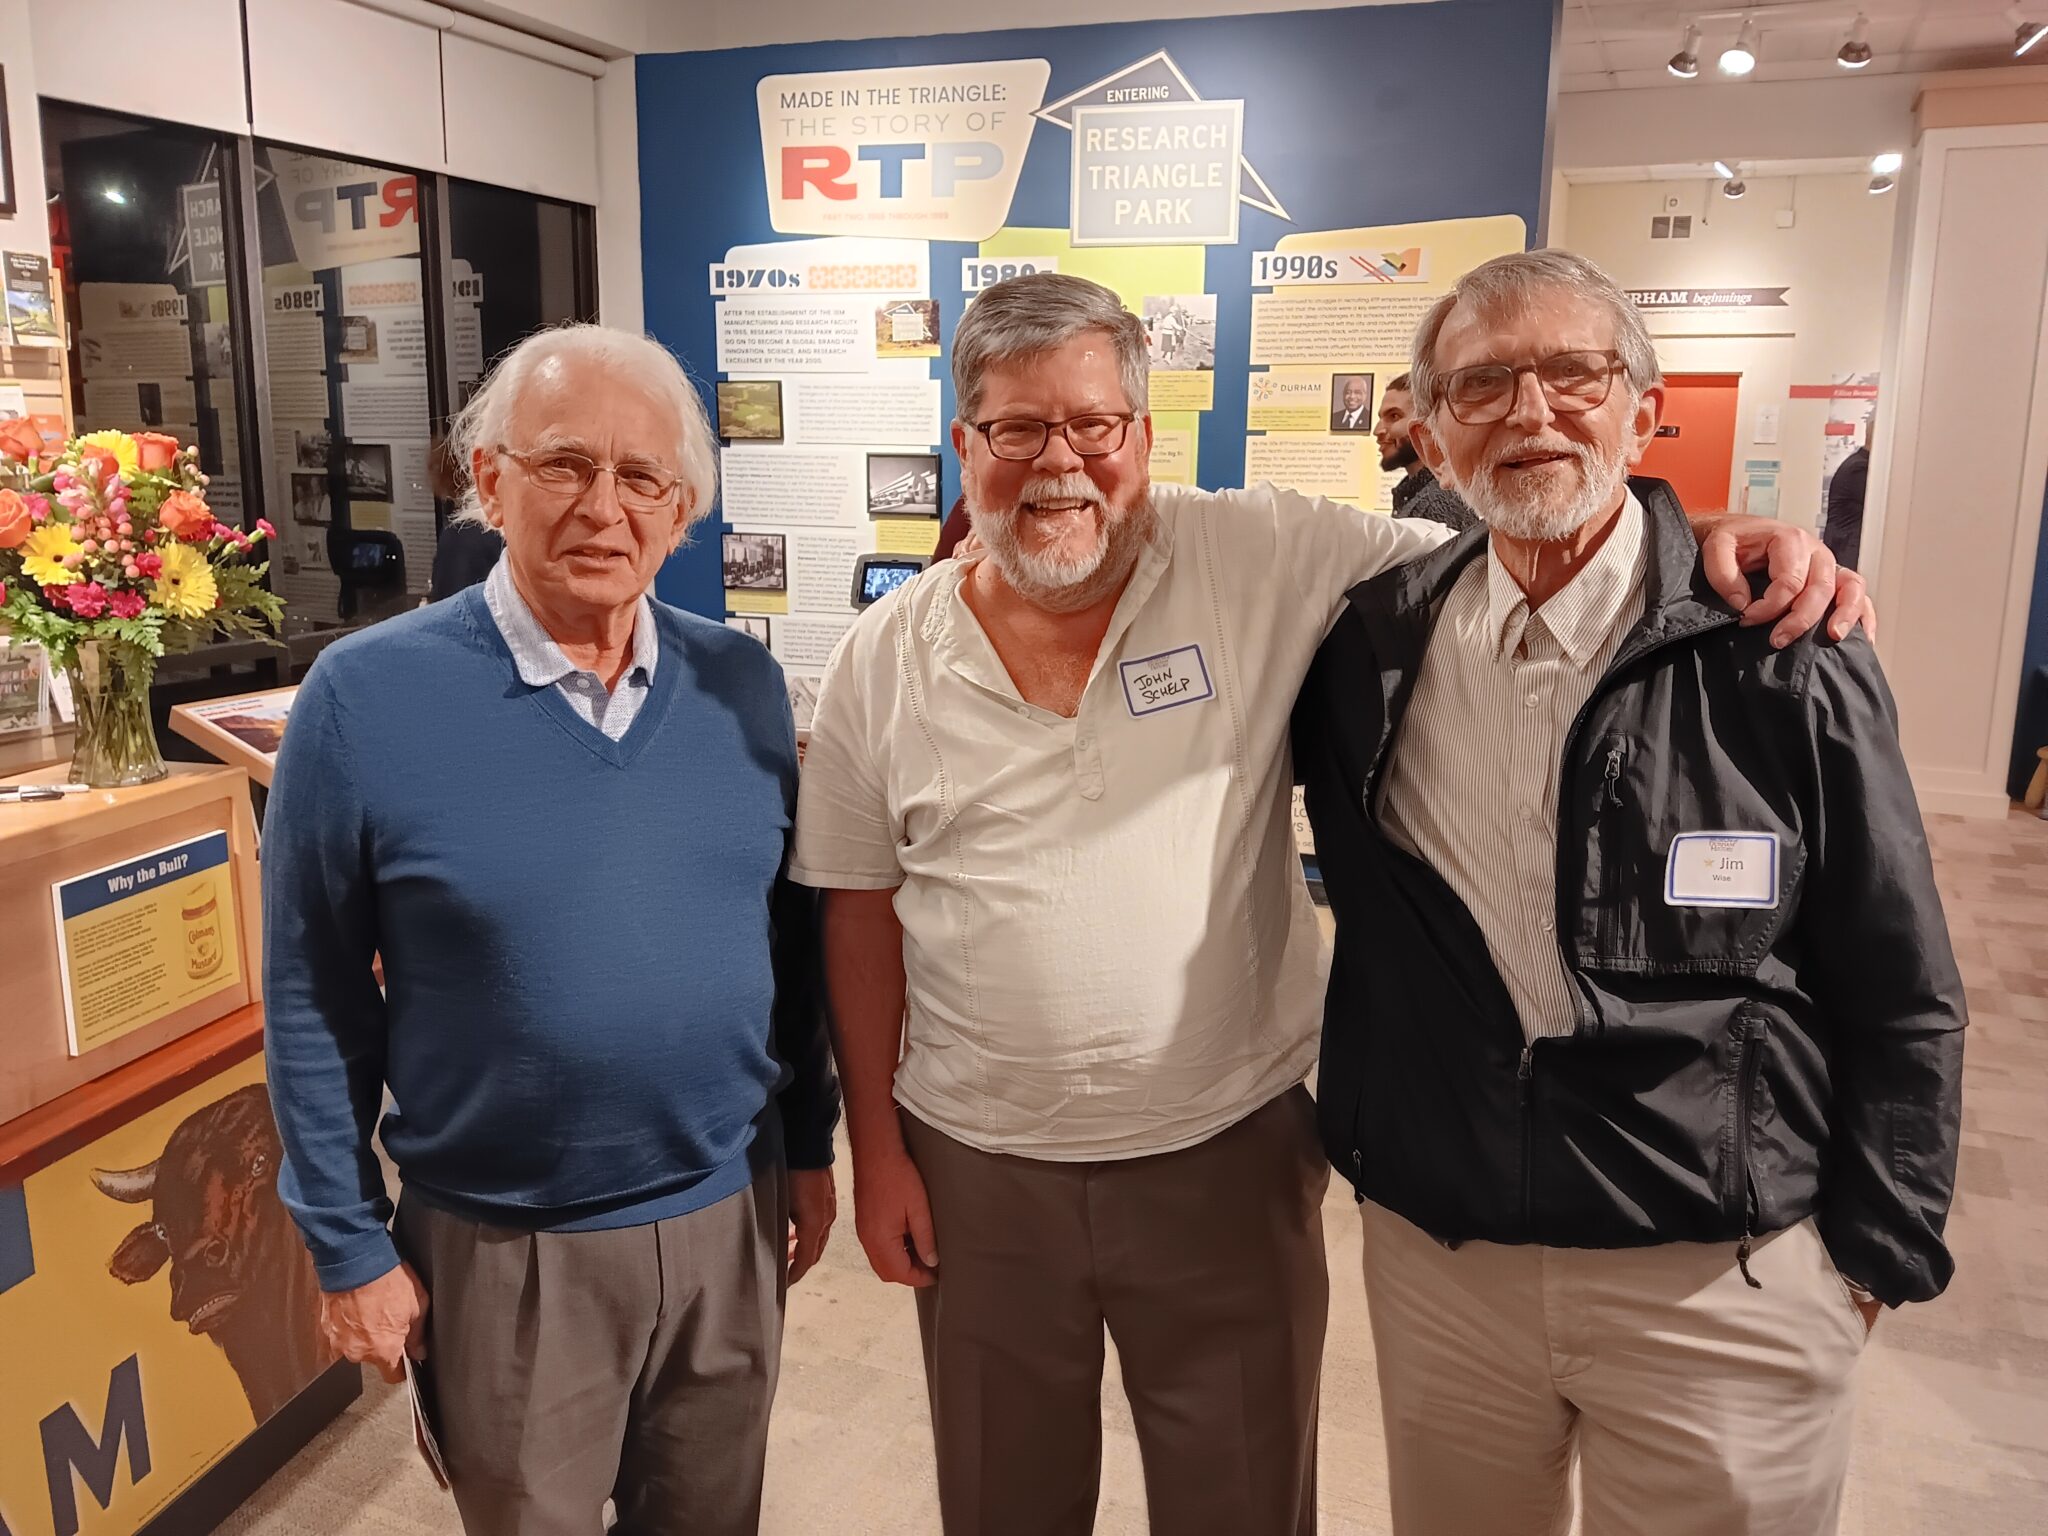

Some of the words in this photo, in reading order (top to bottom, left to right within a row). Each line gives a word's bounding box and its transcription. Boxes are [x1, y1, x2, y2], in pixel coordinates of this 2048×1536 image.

[781, 92, 833, 109] MADE
[841, 90, 858, 107] IN
[867, 88, 900, 105] THE
[908, 84, 1006, 104] TRIANGLE:
[1106, 86, 1169, 103] ENTERING
[780, 117, 836, 136] THE
[851, 113, 950, 135] STORY
[966, 112, 1006, 131] OF
[1086, 124, 1227, 152] RESEARCH
[782, 141, 1004, 200] RTP
[1088, 163, 1223, 190] TRIANGLE
[1115, 198, 1193, 225] PARK
[715, 269, 800, 288] 1970s
[1260, 255, 1338, 280] 1990s
[1693, 293, 1753, 306] beginnings
[1134, 667, 1172, 690] JOHN
[1142, 678, 1190, 704] SCHELP
[107, 874, 134, 894] Why
[137, 867, 156, 884] the
[159, 854, 189, 876] Bull?
[1720, 857, 1744, 870] Jim
[1712, 874, 1731, 882] Wise
